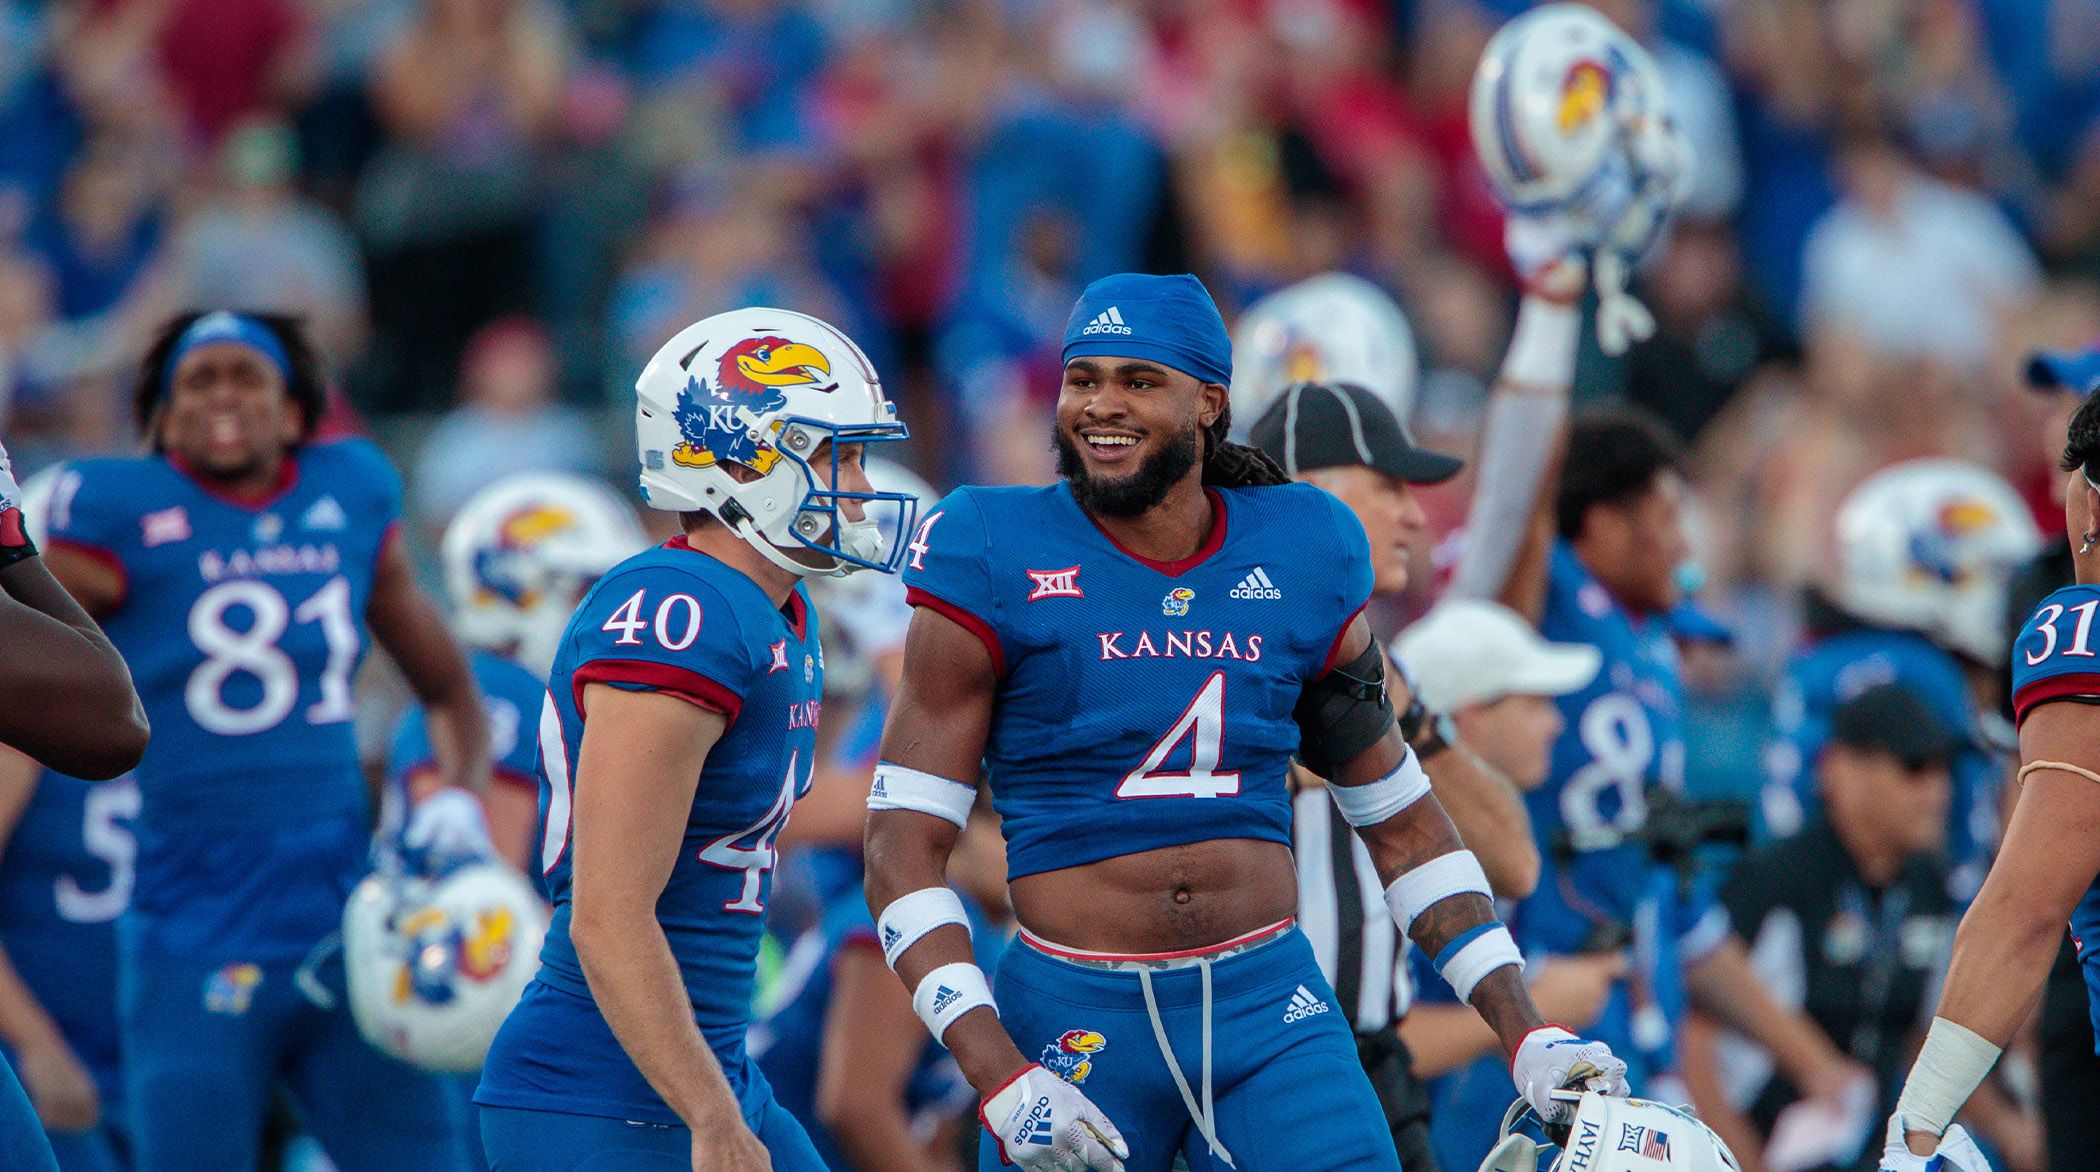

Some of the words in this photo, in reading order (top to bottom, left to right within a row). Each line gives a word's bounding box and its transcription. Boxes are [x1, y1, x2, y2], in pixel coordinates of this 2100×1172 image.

[1083, 323, 1132, 336] adidas
[707, 404, 749, 434] KU
[908, 509, 945, 572] 4
[1029, 568, 1081, 599] XII
[1230, 586, 1282, 600] adidas
[601, 588, 703, 652] 40
[2026, 600, 2100, 667] 31
[184, 576, 359, 736] 81
[1097, 630, 1263, 662] KANSAS
[1114, 669, 1242, 800] 4
[697, 747, 815, 914] 4
[933, 990, 963, 1015] adidas
[1283, 1001, 1329, 1023] adidas
[1057, 1056, 1073, 1067] KU
[1014, 1096, 1050, 1146] adidas
[1569, 1119, 1600, 1172] JAYH
